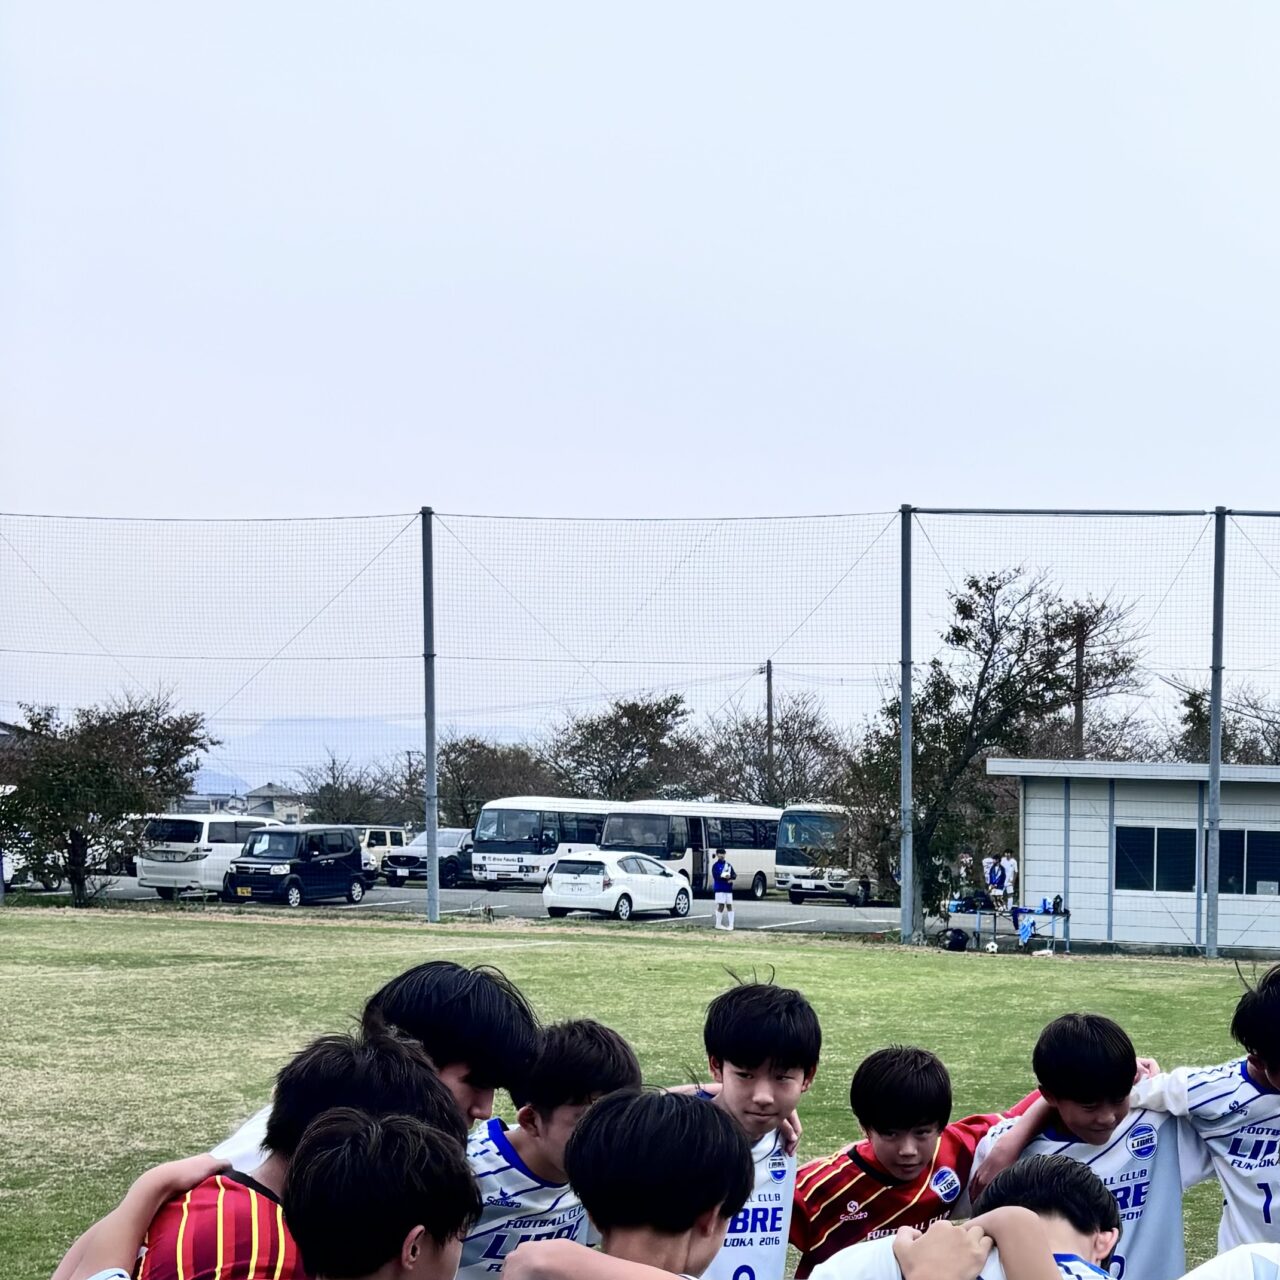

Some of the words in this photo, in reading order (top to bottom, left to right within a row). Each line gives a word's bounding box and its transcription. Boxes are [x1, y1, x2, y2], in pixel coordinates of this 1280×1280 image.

[1240, 1126, 1280, 1136] FOOTB
[1131, 1136, 1155, 1148] LIBRE
[1119, 1168, 1148, 1181] CLUB
[758, 1193, 781, 1202] CLUB
[505, 1213, 565, 1229] FOOTBALL
[728, 1207, 783, 1234] BRE
[723, 1237, 754, 1247] UOKA
[759, 1236, 780, 1246] 2016
